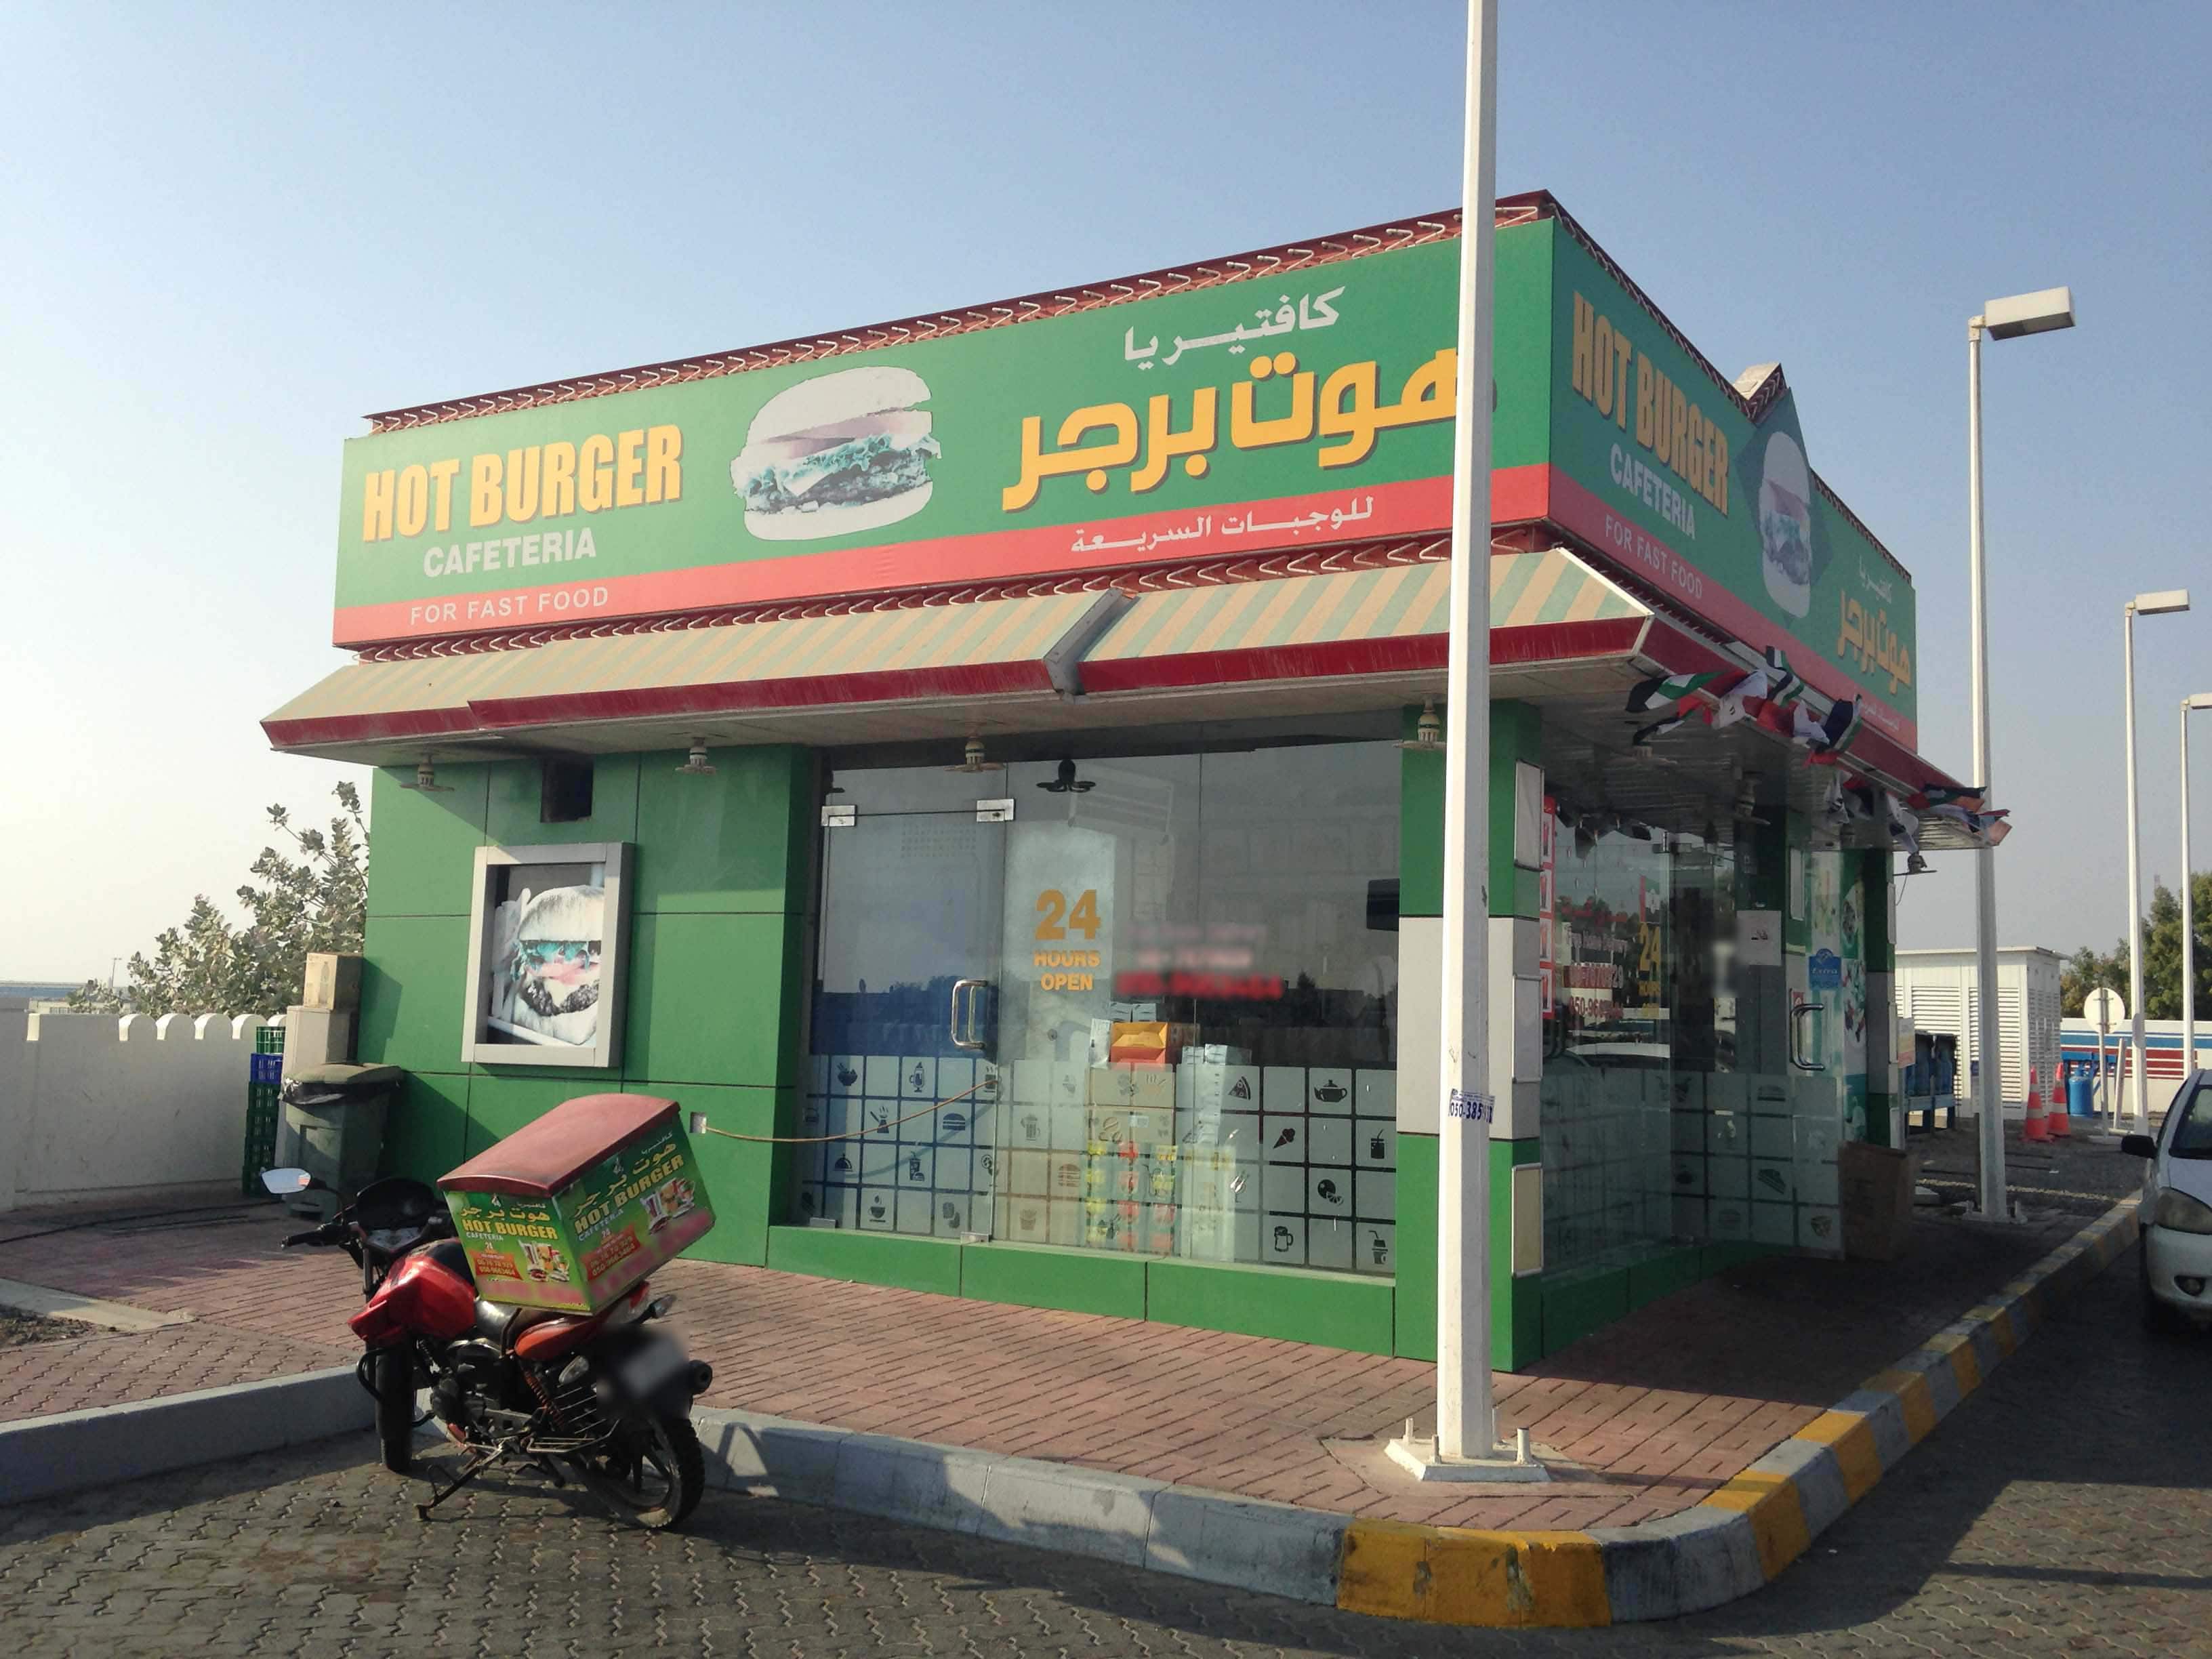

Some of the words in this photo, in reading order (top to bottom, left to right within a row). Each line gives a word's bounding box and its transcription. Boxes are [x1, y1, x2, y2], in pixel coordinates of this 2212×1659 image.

[1124, 285, 1346, 371] كافتيريا
[1572, 290, 1633, 432] HOT
[1636, 351, 1729, 519] BURGER
[1002, 386, 1218, 514] برجر
[362, 457, 462, 543] HOT
[469, 424, 683, 529] BURGER
[1610, 443, 1696, 541] CAFETERIA
[1071, 514, 1212, 553] السريعة
[1221, 495, 1374, 534] للوجبات
[424, 527, 597, 578] CAFETERIA
[1605, 514, 1633, 554] FOR
[1637, 533, 1667, 575] FAST
[1671, 558, 1702, 600] FOOD
[410, 602, 456, 626] FOR
[468, 595, 528, 619] FAST
[538, 586, 610, 612] FOOD
[1035, 888, 1101, 940] 24
[1033, 950, 1101, 968] HOURS
[1041, 972, 1093, 991] OPEN
[575, 1200, 611, 1234] HOT
[614, 1154, 684, 1208] BURGER
[461, 1219, 491, 1233] HOT
[495, 1222, 558, 1240] BURGER
